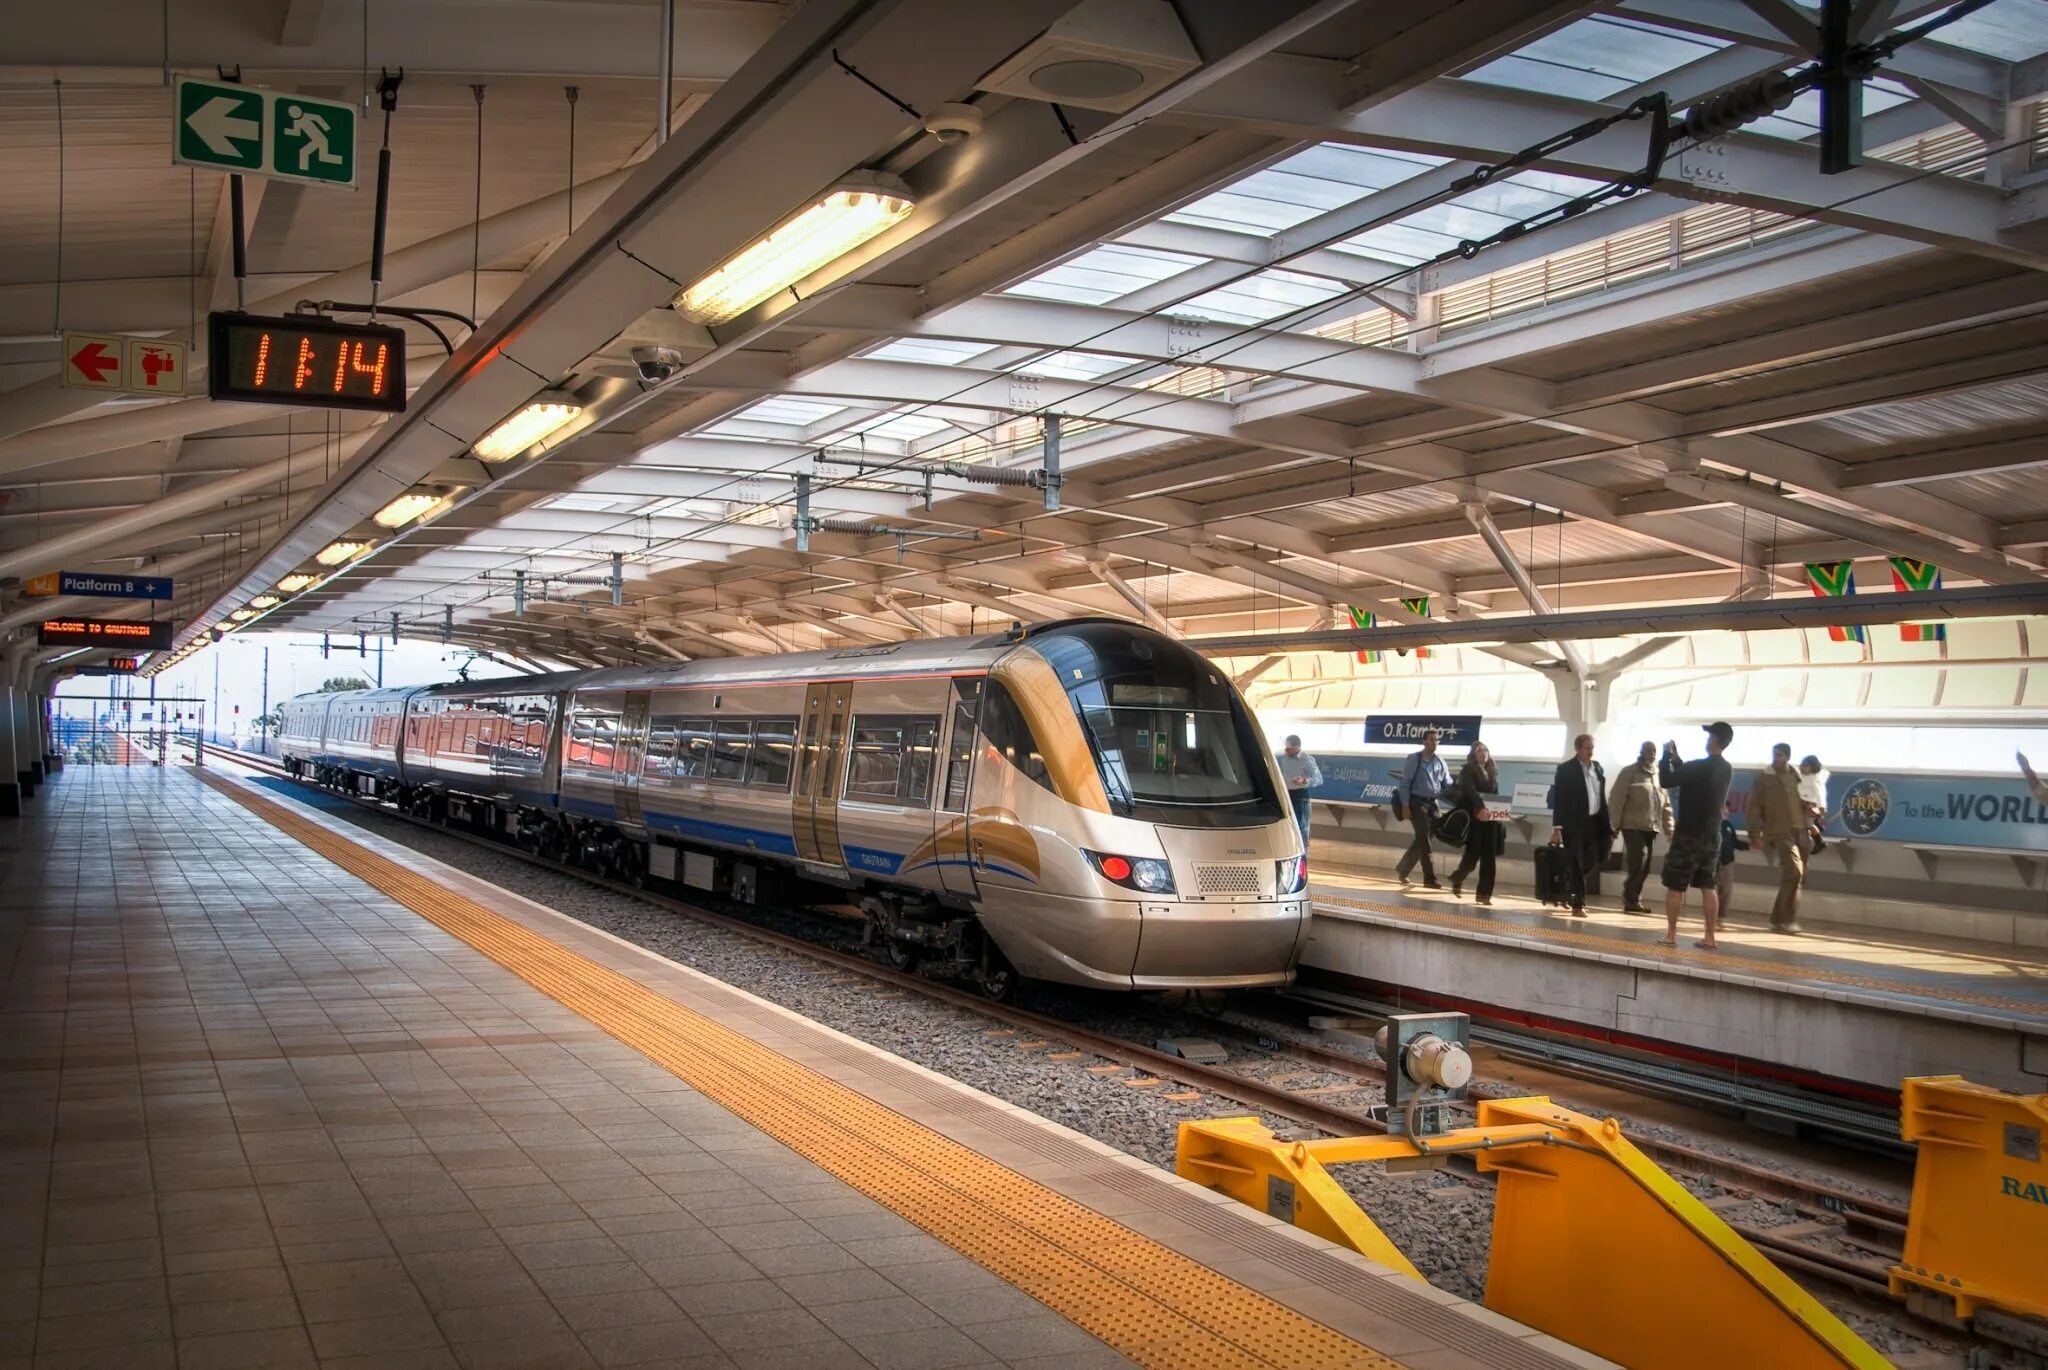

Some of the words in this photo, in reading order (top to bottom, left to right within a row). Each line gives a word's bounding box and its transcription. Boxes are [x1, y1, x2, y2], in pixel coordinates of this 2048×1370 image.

[254, 333, 387, 395] 11:14
[64, 578, 122, 592] Platform
[126, 581, 134, 593] B
[43, 621, 85, 633] WELCOME
[89, 623, 101, 633] TO
[104, 624, 150, 636] GAUTRAIN
[1845, 797, 1886, 811] AFRICA
[1922, 804, 1945, 819] the
